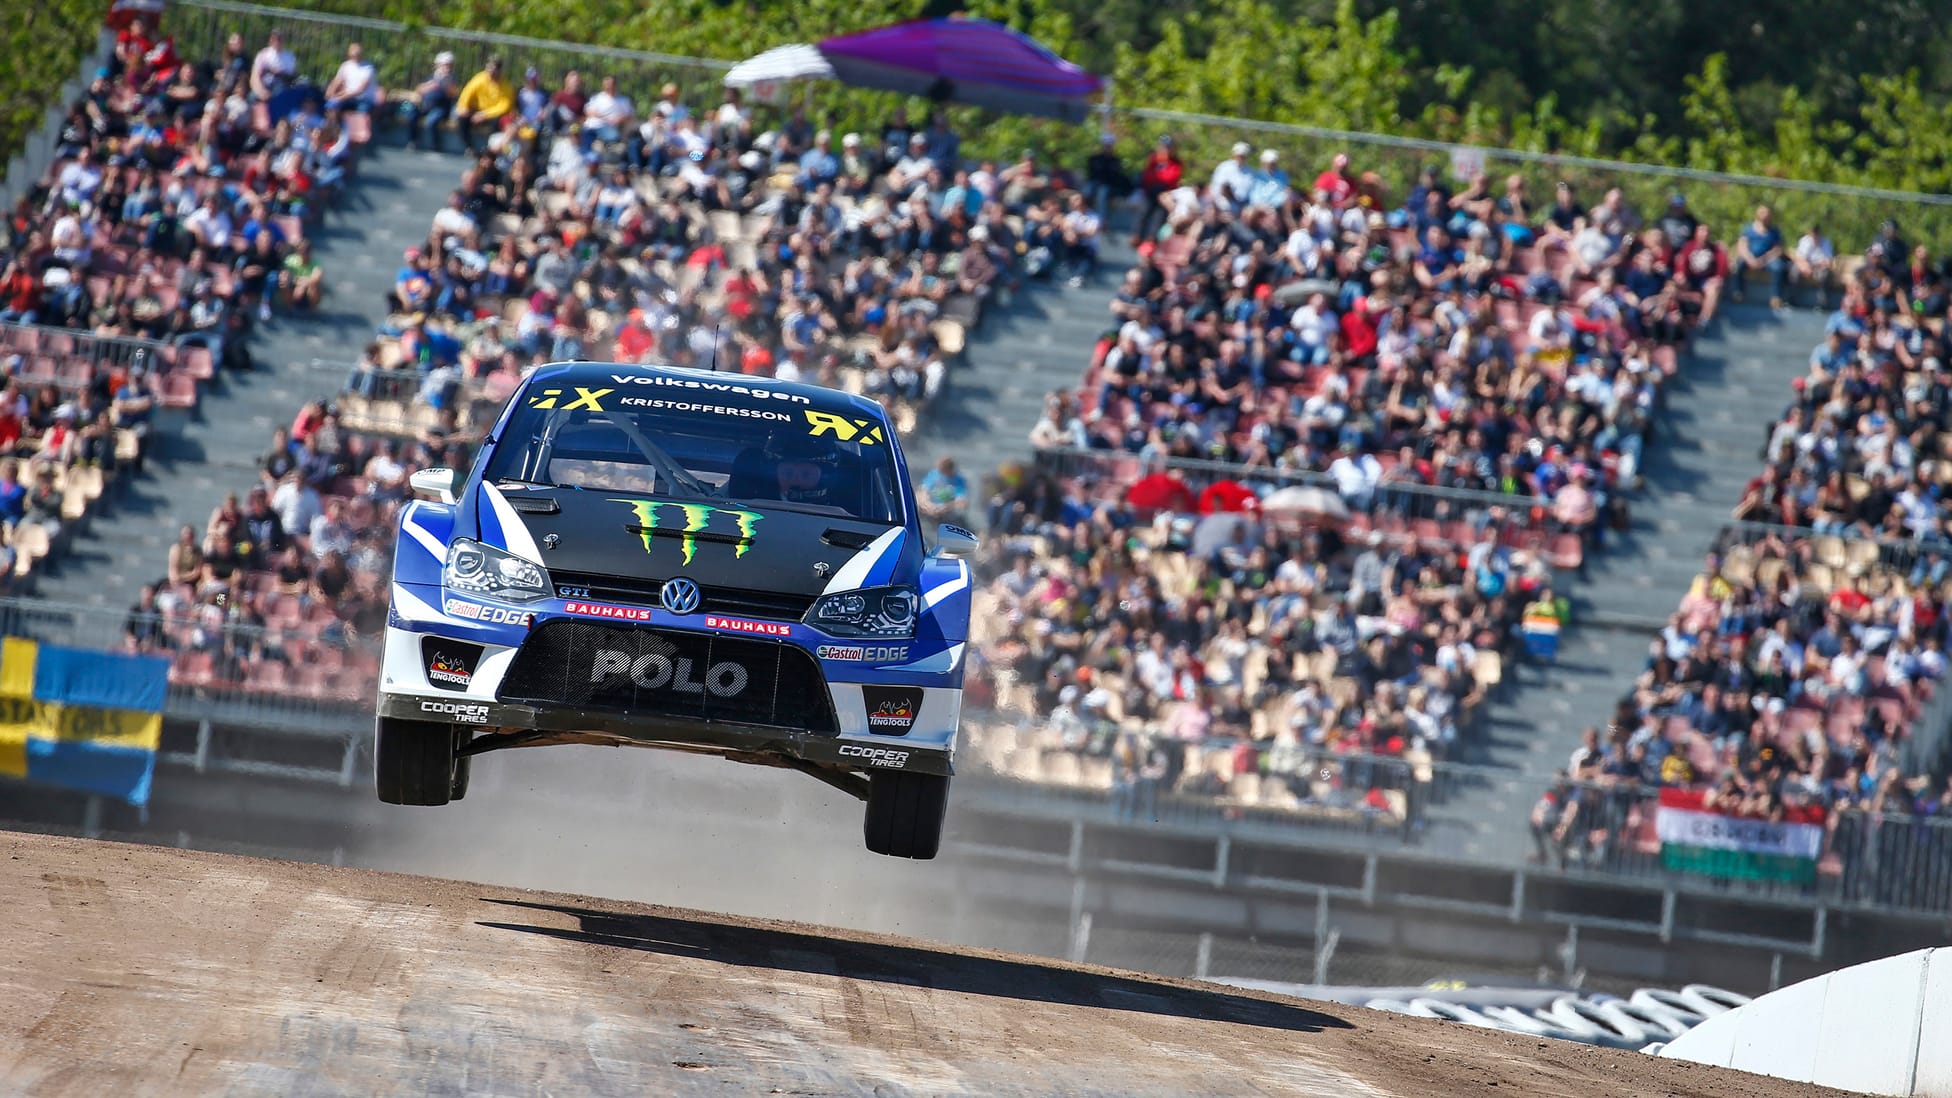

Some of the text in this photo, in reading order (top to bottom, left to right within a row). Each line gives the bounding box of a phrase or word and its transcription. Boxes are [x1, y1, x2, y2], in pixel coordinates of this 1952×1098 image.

[611, 375, 810, 404] Volkswagen
[620, 397, 792, 422] KRISTOFFERSSON
[559, 586, 591, 598] GTI
[450, 600, 537, 626] Castrol EDGE
[565, 603, 651, 620] BAUHAUS
[706, 617, 790, 635] BAUHAUS
[827, 646, 909, 661] Castrol EDGE
[590, 649, 749, 697] POLO
[421, 701, 490, 716] COOPER
[454, 714, 488, 723] TIRES
[838, 745, 910, 761] COOPER
[870, 758, 906, 768] TIRES
